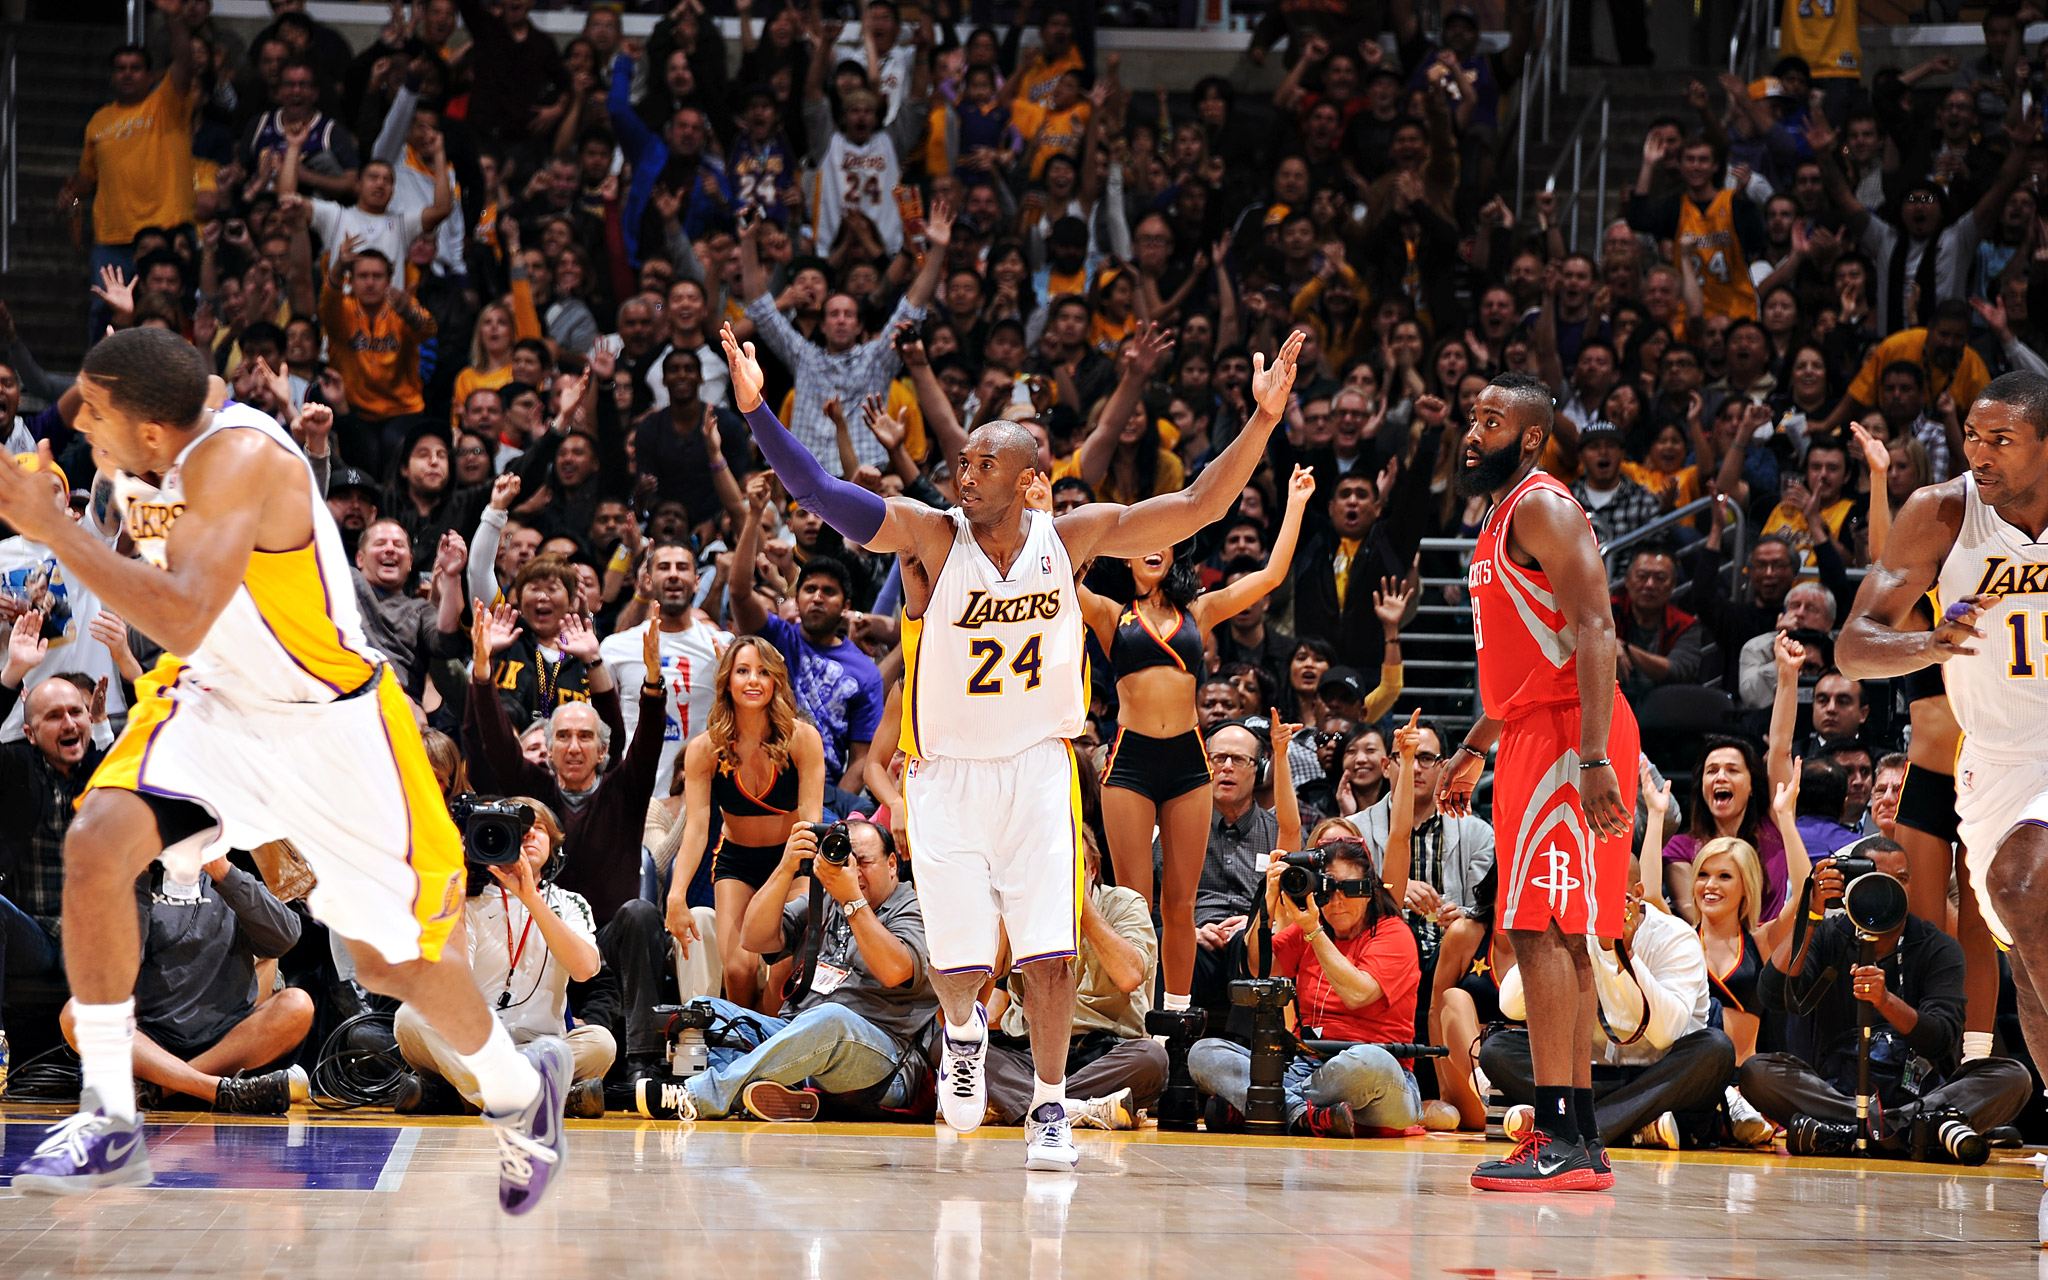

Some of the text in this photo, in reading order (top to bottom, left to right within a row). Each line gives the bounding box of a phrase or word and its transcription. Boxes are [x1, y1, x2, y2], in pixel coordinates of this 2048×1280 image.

[739, 174, 776, 204] 24
[844, 171, 883, 205] 24
[1469, 559, 1491, 590] CKETS
[1973, 556, 2048, 602] LAK
[952, 588, 1061, 630] LAKERS
[966, 632, 1043, 696] 24
[2006, 610, 2048, 678] 1
